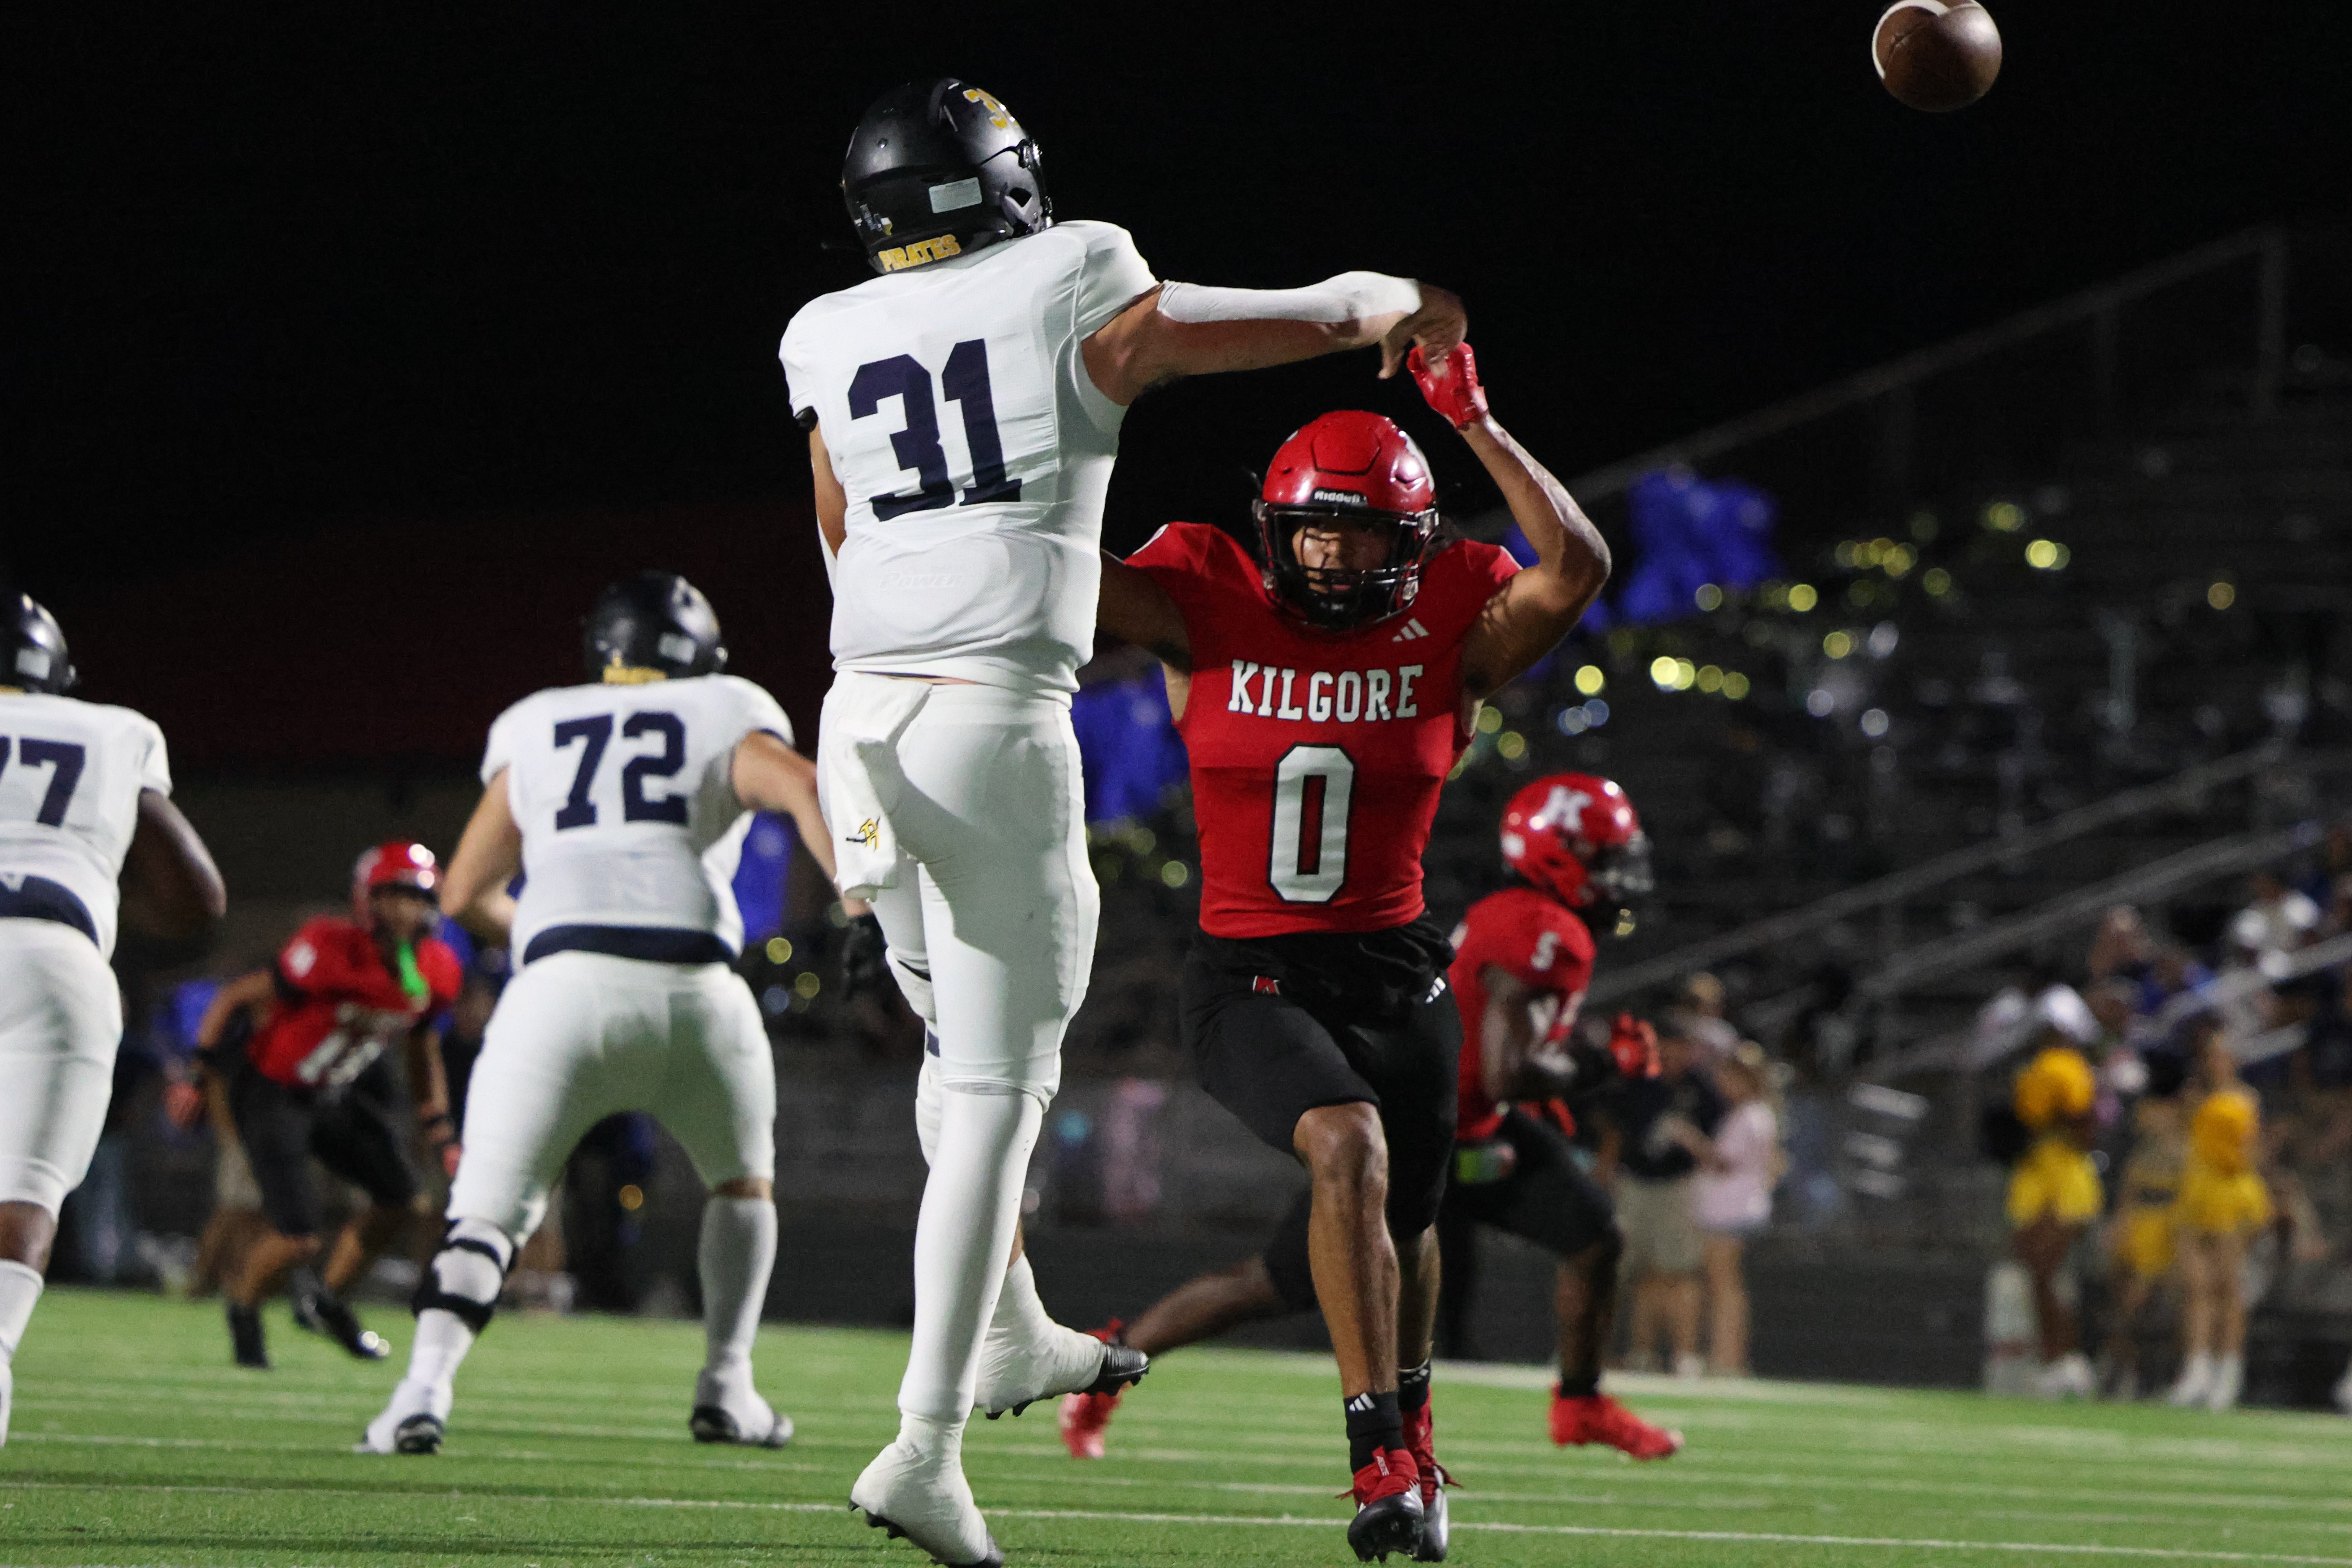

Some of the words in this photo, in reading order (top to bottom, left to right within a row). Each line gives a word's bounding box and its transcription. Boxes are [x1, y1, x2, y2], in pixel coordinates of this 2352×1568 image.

[878, 234, 961, 272] PIRATES
[848, 338, 1021, 522] 31
[1228, 659, 1423, 722] KILGORE
[0, 736, 85, 828] 7
[554, 712, 689, 831] 72
[1267, 742, 1357, 904] 0
